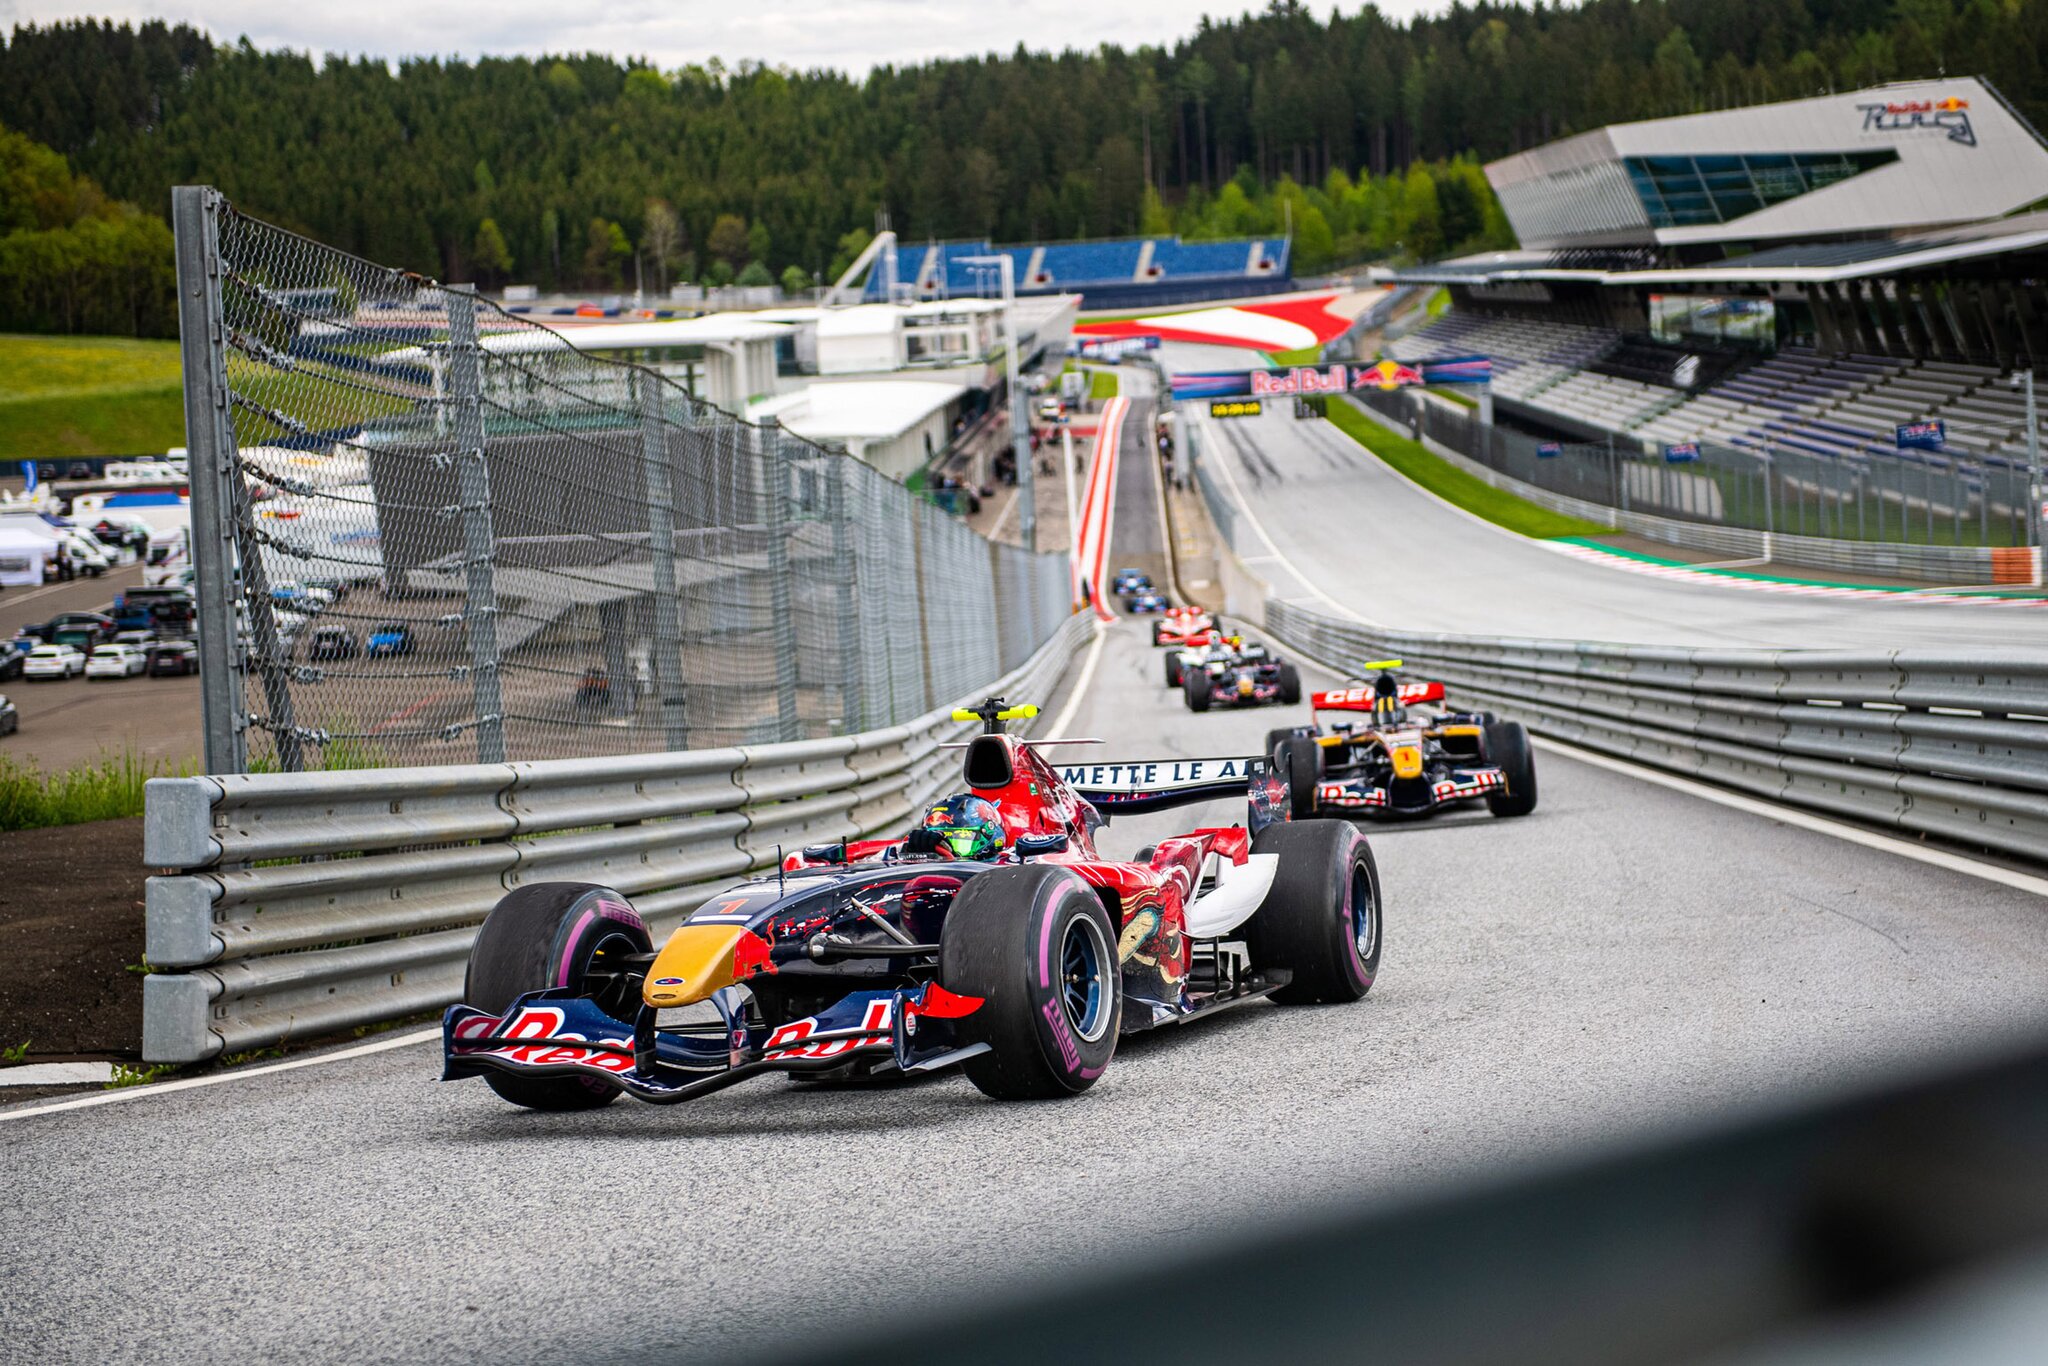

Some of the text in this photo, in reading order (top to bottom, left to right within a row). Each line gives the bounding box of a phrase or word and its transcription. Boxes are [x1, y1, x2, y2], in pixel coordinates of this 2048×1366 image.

[1253, 365, 1347, 394] Red Bull
[1324, 683, 1429, 703] CEA
[1063, 764, 1157, 785] METTE
[1173, 762, 1202, 782] LE
[719, 899, 749, 914] 1
[496, 1008, 636, 1073] Red
[1042, 997, 1081, 1074] PIRELLI
